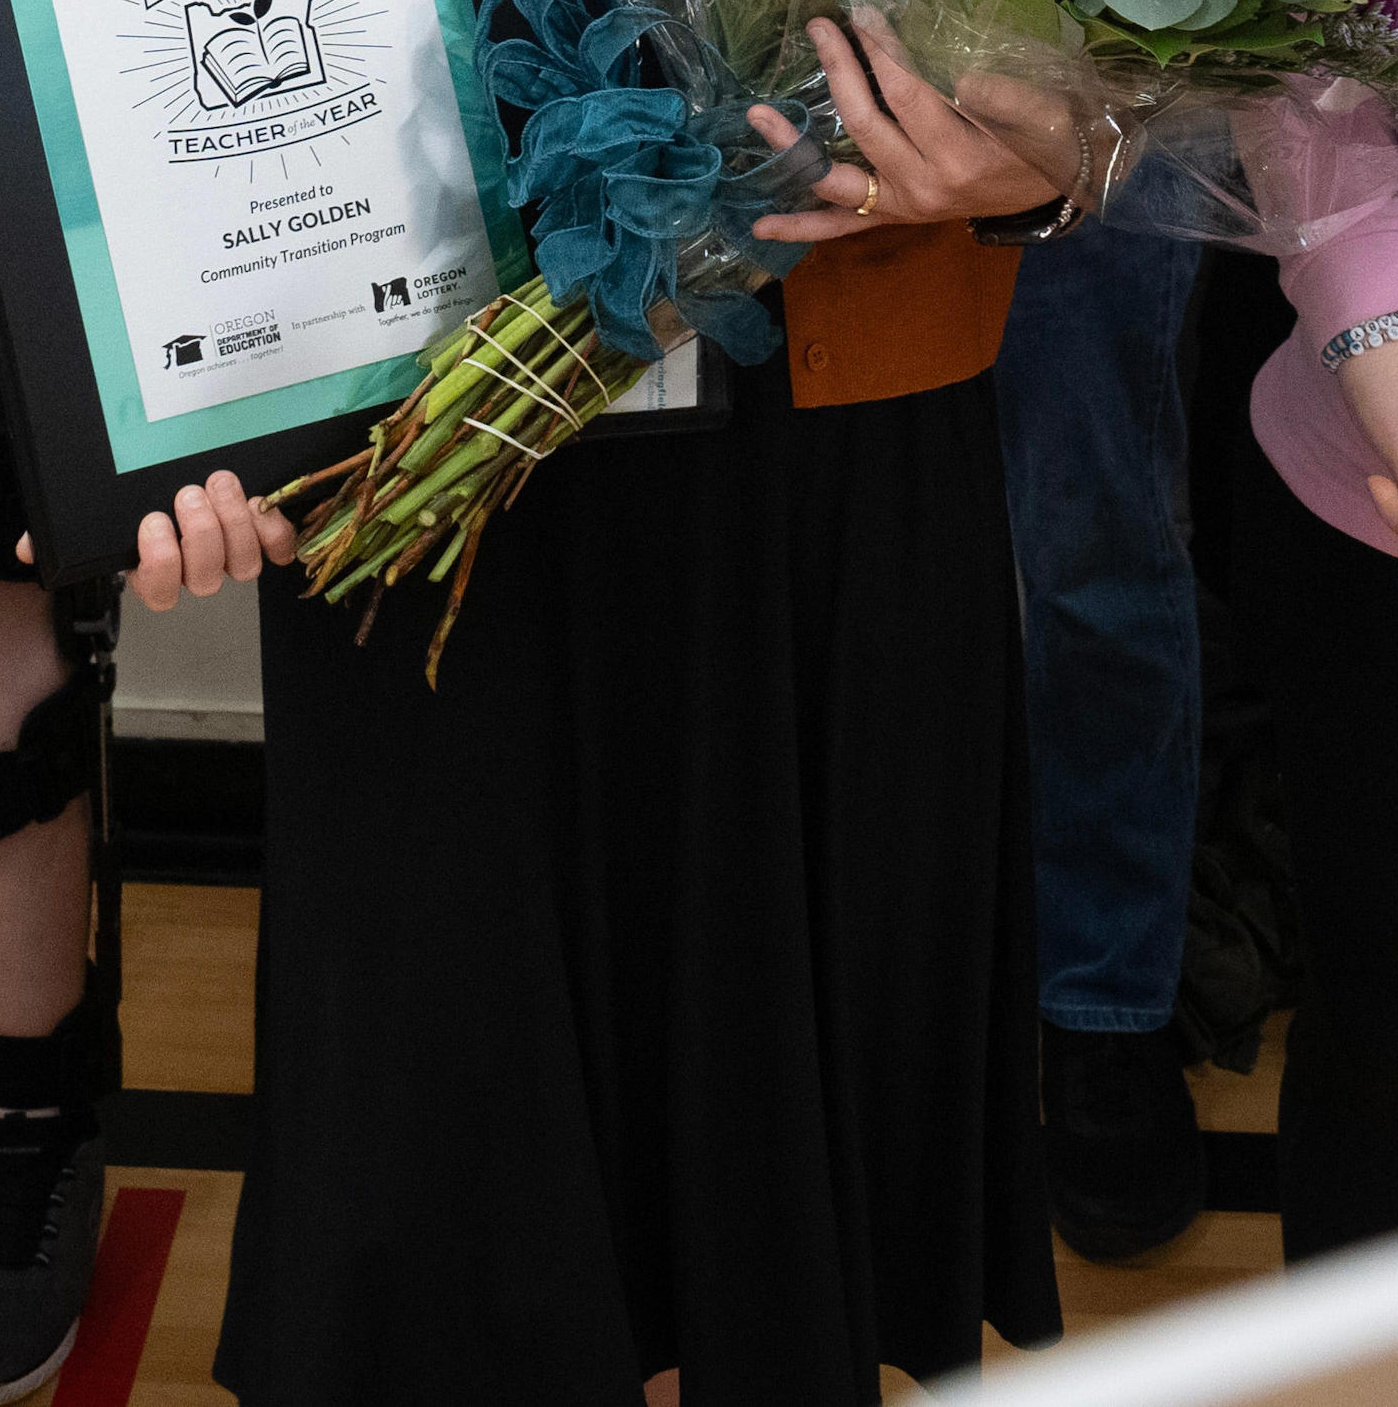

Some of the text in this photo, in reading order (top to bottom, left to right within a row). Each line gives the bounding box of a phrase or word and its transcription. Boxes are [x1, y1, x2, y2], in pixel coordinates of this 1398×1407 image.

[168, 93, 378, 155] TEACHER of the YEAR
[250, 183, 334, 214] Presented to
[222, 198, 372, 249] SALLY GOLDEN
[200, 223, 406, 284] Community Transition Program
[413, 267, 467, 289] OREGON
[214, 309, 276, 335] OREGON
[291, 304, 366, 331] In partnership with
[378, 314, 409, 327] Together,
[421, 307, 432, 315] do
[433, 302, 452, 314] good
[216, 324, 279, 346] DEPARTMENT OF
[219, 332, 281, 356] EDUCATION
[179, 367, 205, 379] Oregon
[207, 359, 237, 372] achieves
